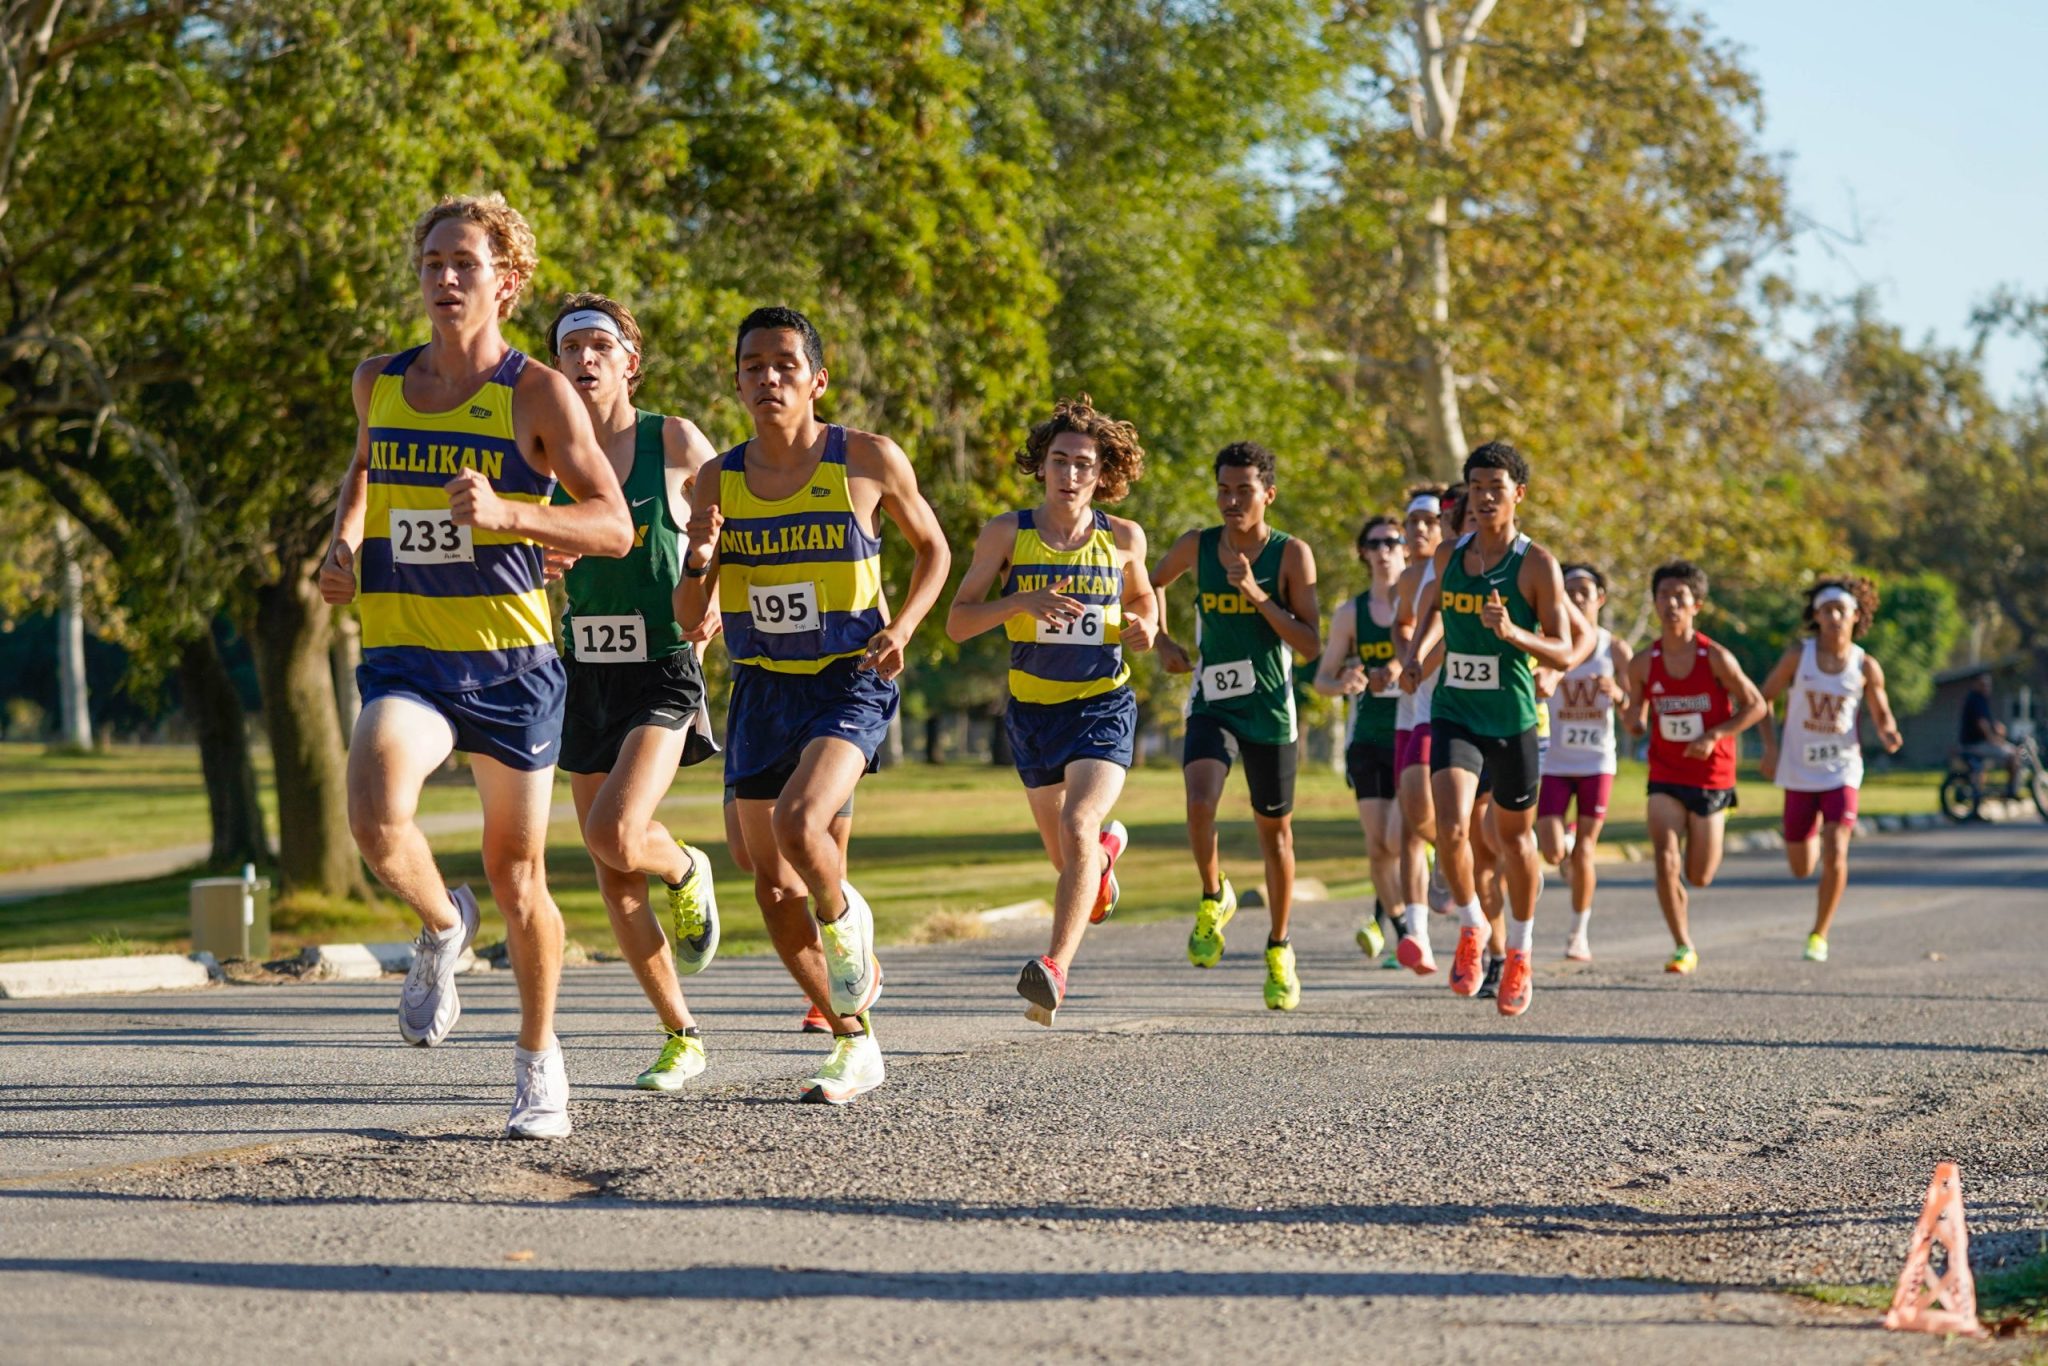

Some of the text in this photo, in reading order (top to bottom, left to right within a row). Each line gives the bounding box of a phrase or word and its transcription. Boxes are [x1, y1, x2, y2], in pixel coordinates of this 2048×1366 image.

[398, 519, 462, 553] 233
[720, 524, 847, 555] MILLIKAN
[752, 592, 808, 624] 195
[1202, 593, 1271, 614] POL
[582, 625, 637, 653] 125
[1215, 669, 1242, 691] 82
[1453, 661, 1491, 681] 123
[1560, 679, 1601, 707] W
[1805, 689, 1846, 721] W
[1567, 728, 1600, 746] 276
[1669, 720, 1692, 736] 75
